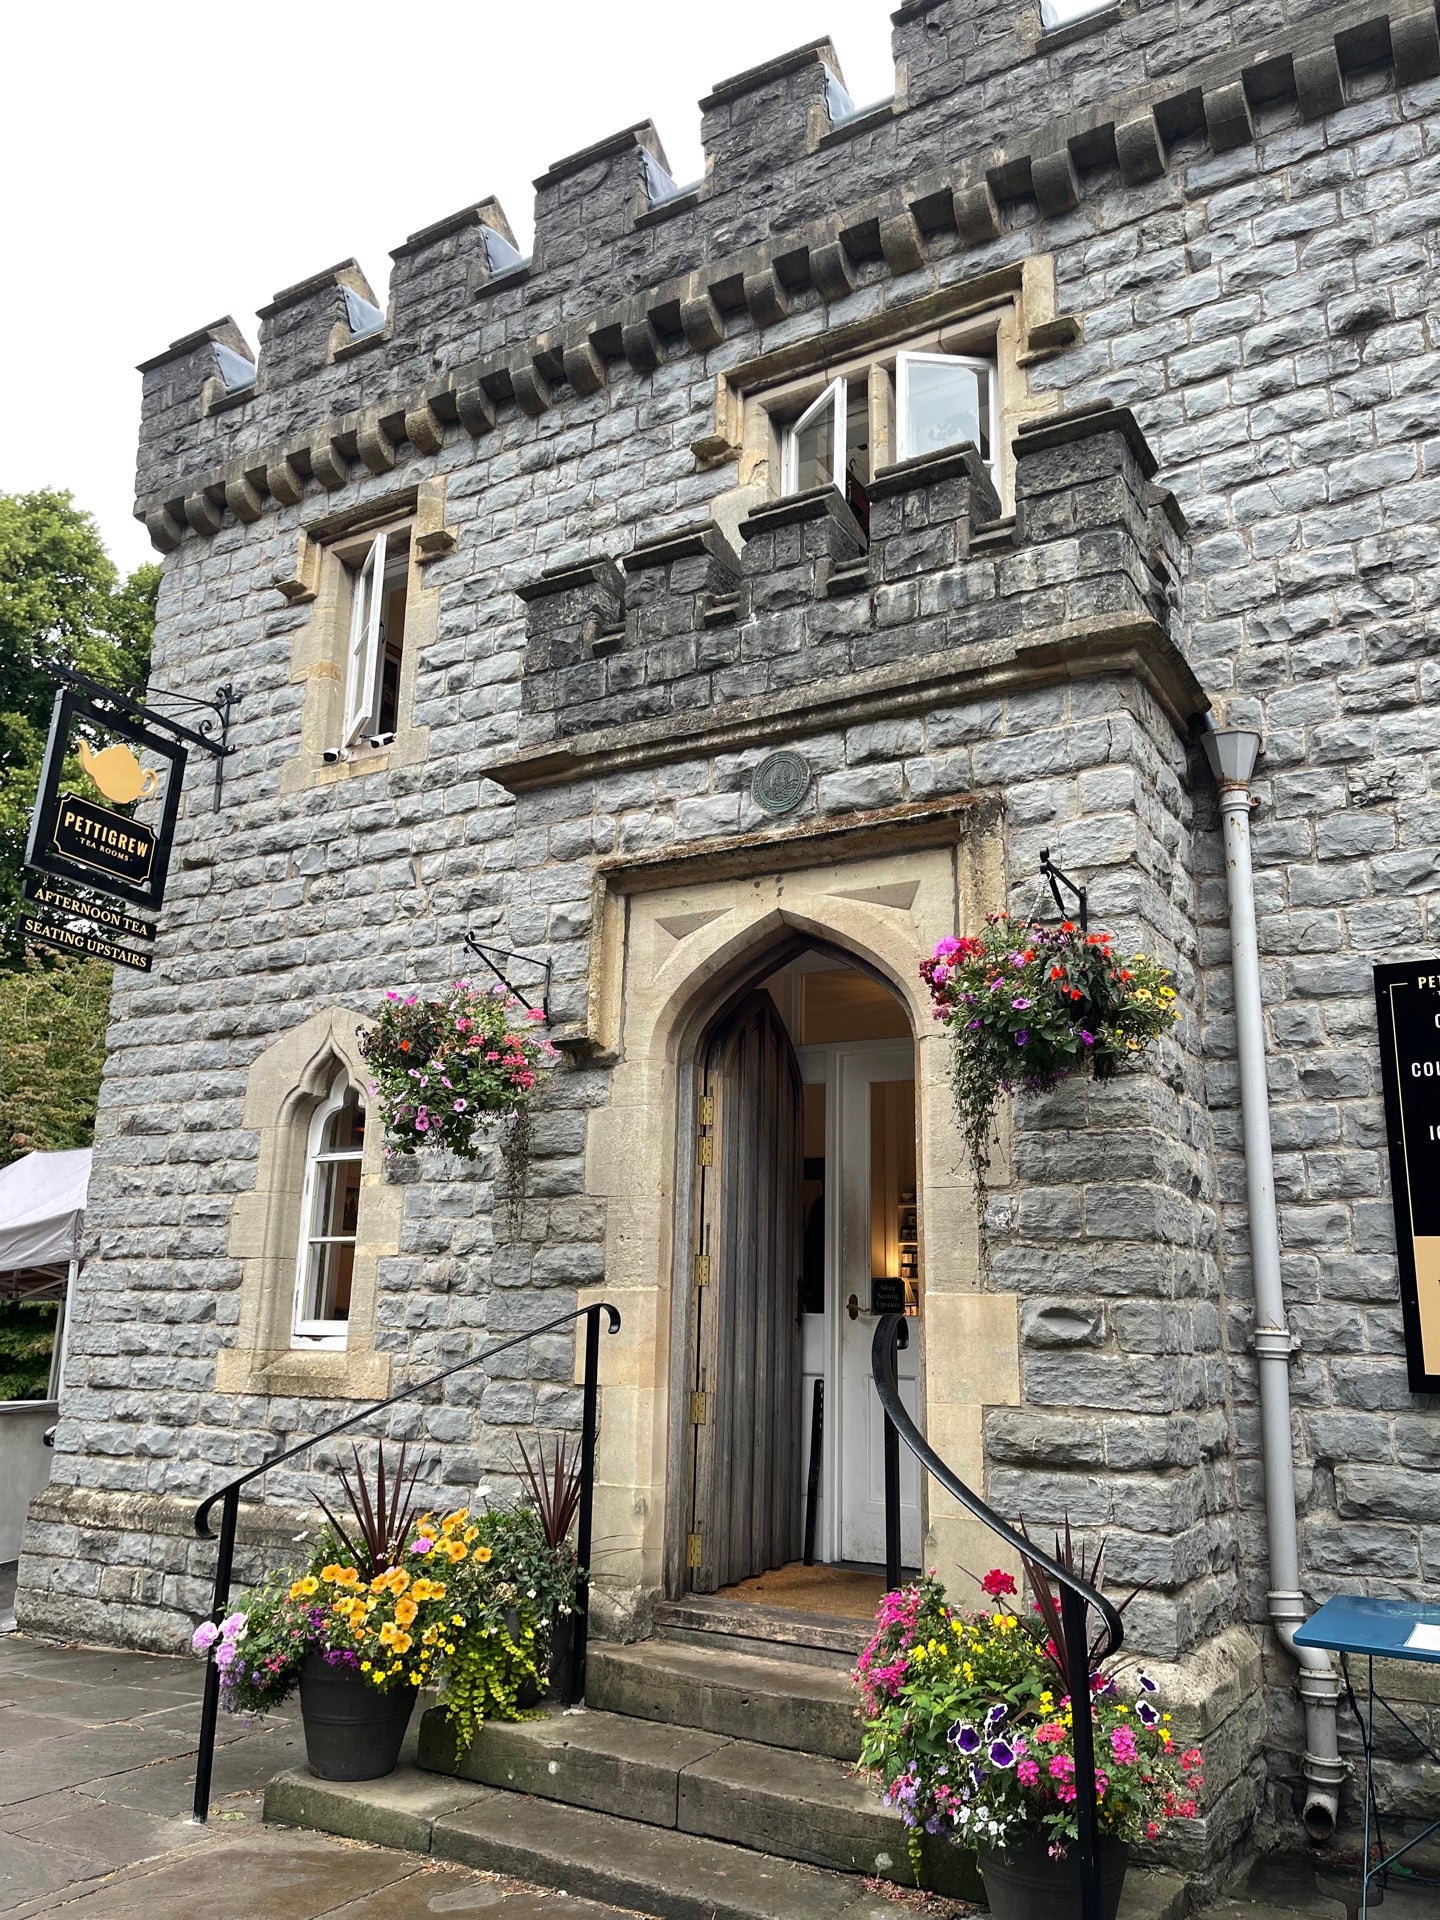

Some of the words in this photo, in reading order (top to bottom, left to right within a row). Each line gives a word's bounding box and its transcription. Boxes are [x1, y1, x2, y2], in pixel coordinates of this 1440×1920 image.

[64, 811, 148, 858] PETTIGREW
[80, 837, 96, 849] TEA
[99, 845, 129, 862] ROOMS
[34, 888, 121, 927] AFTERNOON
[122, 917, 148, 936] TEA
[24, 919, 85, 948] SEATING
[86, 939, 147, 968] UPSTAIRS
[876, 1300, 901, 1310] Upstairs
[877, 1292, 899, 1301] Seating
